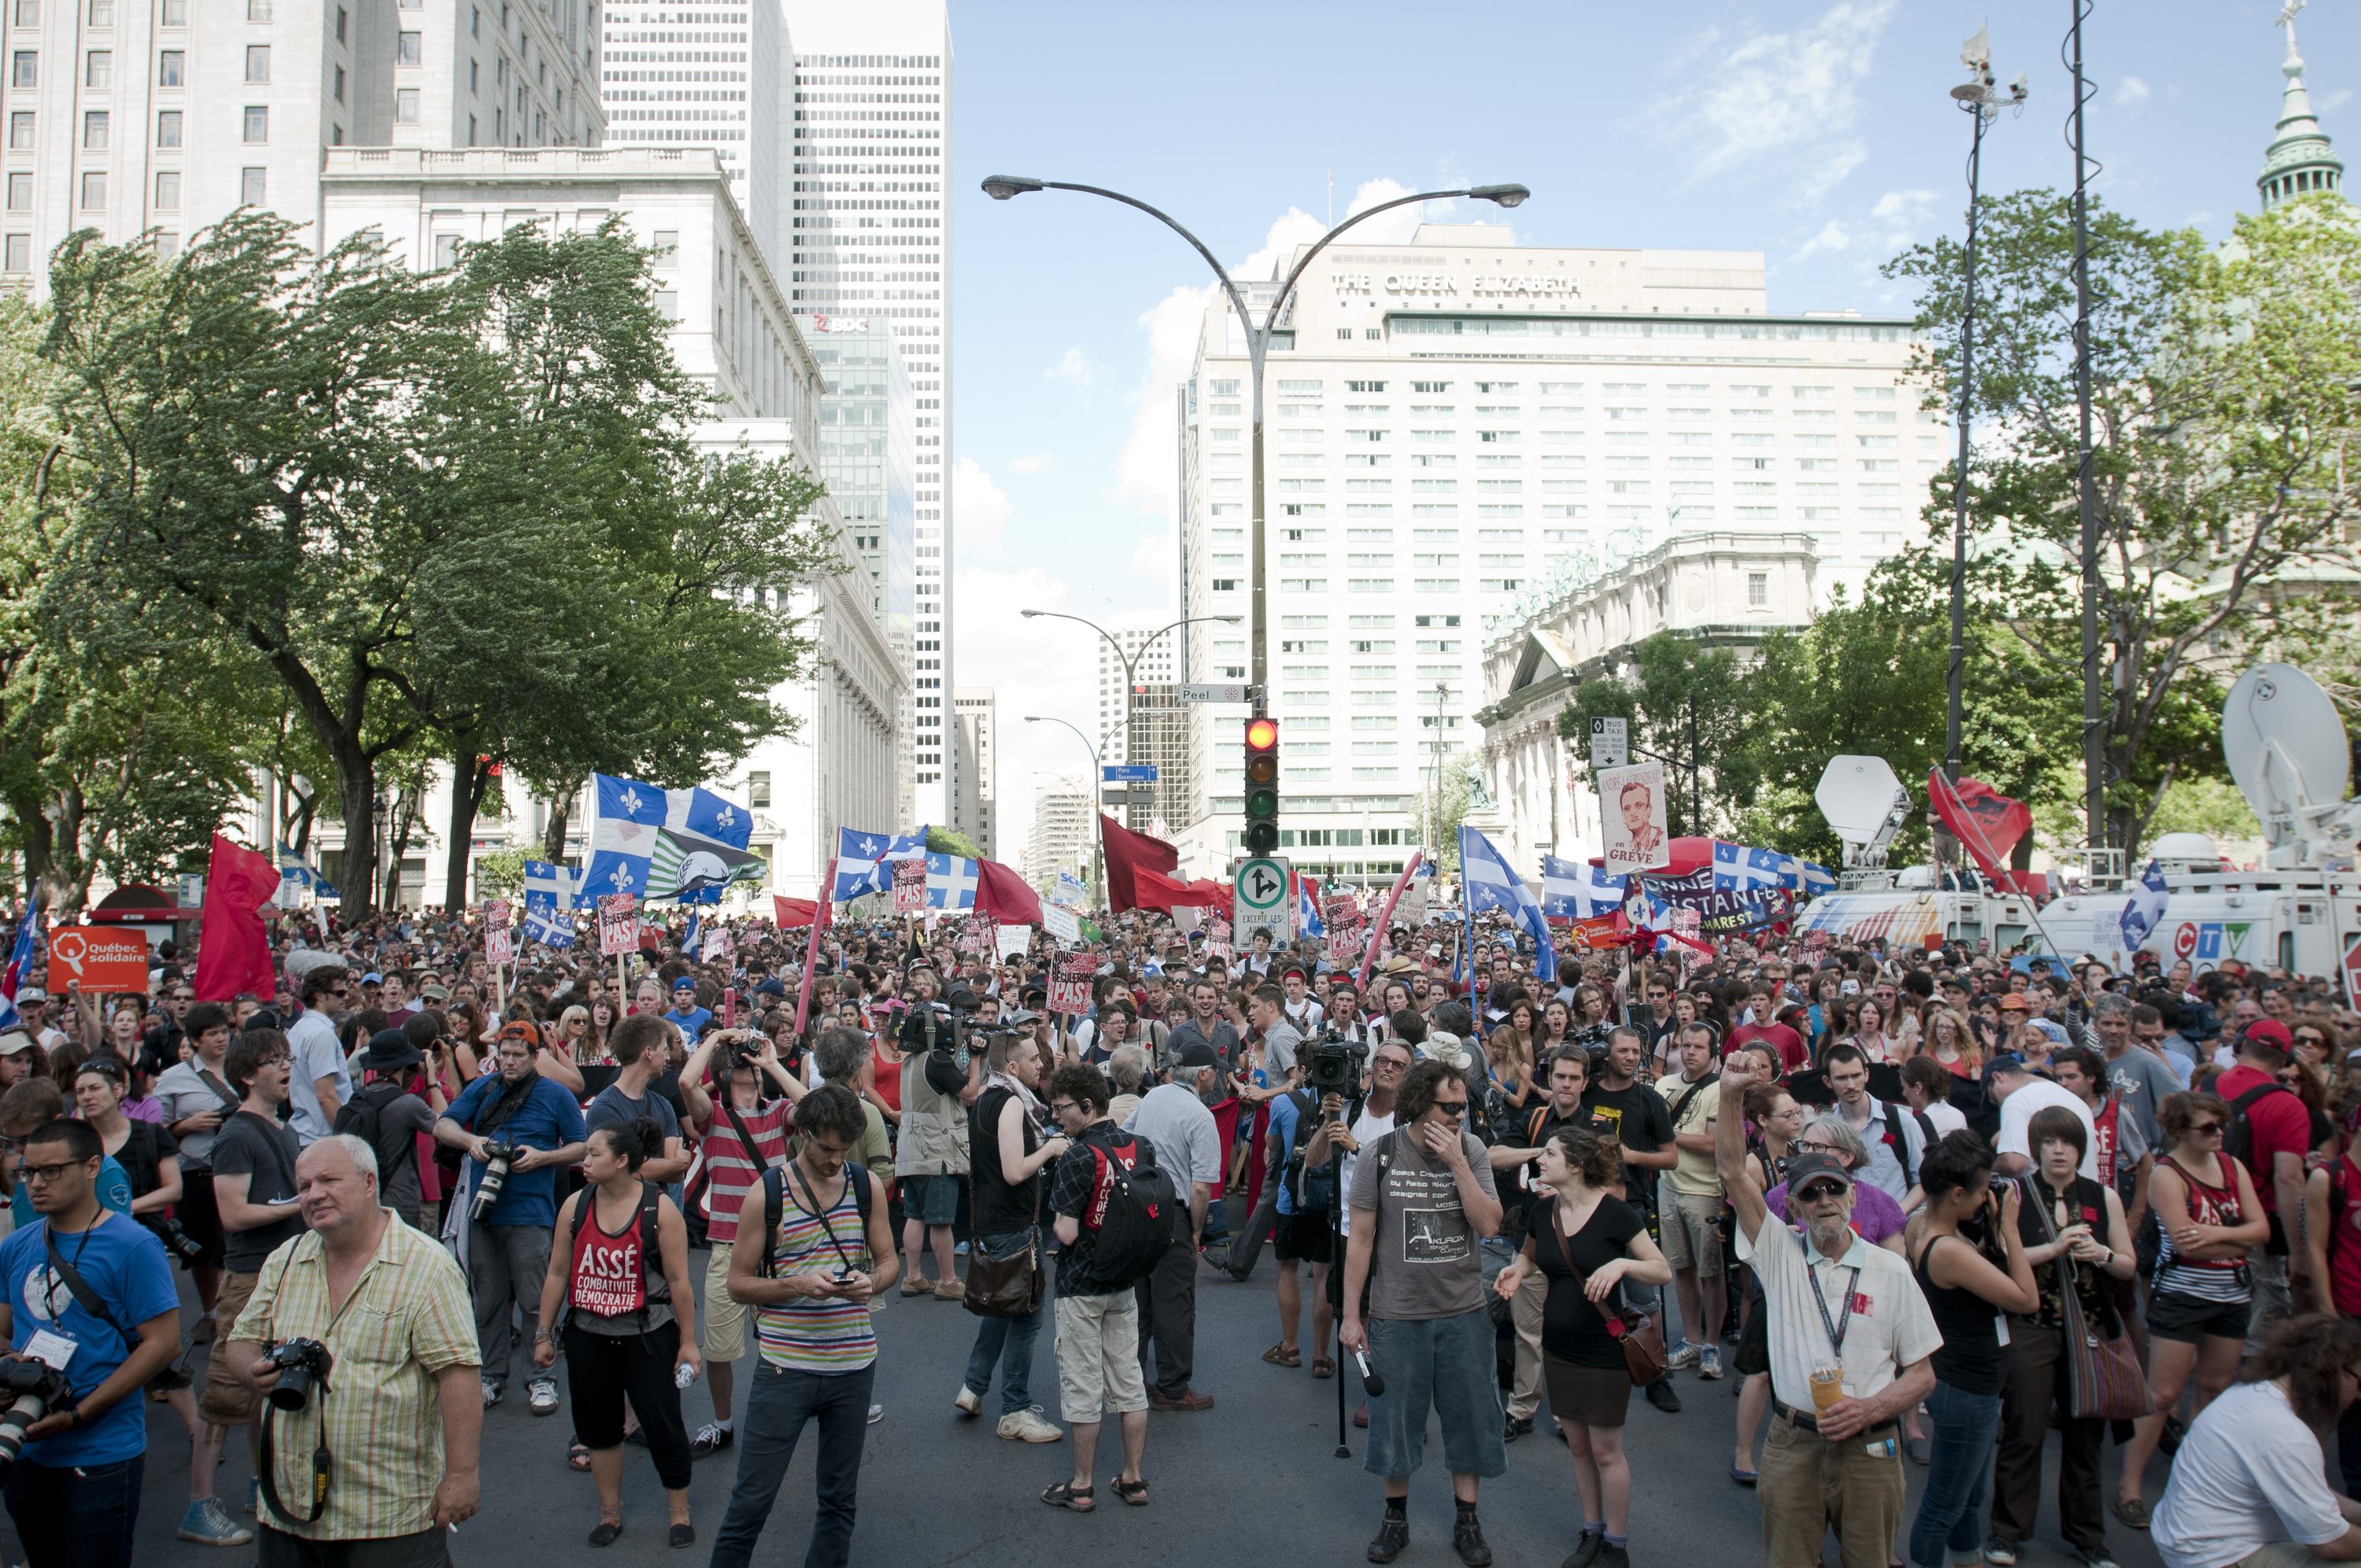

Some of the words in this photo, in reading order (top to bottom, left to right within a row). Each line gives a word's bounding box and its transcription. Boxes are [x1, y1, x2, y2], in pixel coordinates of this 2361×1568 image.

[1332, 273, 1370, 293] THE
[1385, 274, 1458, 293] QUEEN
[1473, 275, 1581, 295] ELIZABETH
[831, 318, 867, 333] BDC
[1183, 690, 1209, 699] Peel
[1609, 847, 1653, 864] GRÈVE
[892, 859, 909, 870] NOUS
[898, 884, 921, 902] PAS
[1327, 904, 1343, 918] NOUS
[1700, 911, 1753, 929] CHAREST
[488, 929, 507, 954] PAS
[606, 922, 631, 944] PAS
[1332, 927, 1355, 950] PAS
[2176, 924, 2251, 956] CTV
[89, 943, 138, 954] Québec
[1053, 950, 1073, 963] NOUS
[1210, 942, 1226, 958] PAS
[1682, 950, 1698, 961] NOUS
[89, 953, 145, 962] solidaire
[1801, 950, 1820, 967] PAS
[1052, 972, 1095, 983] RECULERONS
[1055, 981, 1085, 1004] PAS
[2114, 1068, 2141, 1094] Cruz
[578, 1243, 637, 1278] ASSÉ
[577, 1276, 637, 1293] COMBATIVITÉ
[575, 1289, 636, 1305] DÉMOCRATIE
[317, 1474, 327, 1503] Nikon
